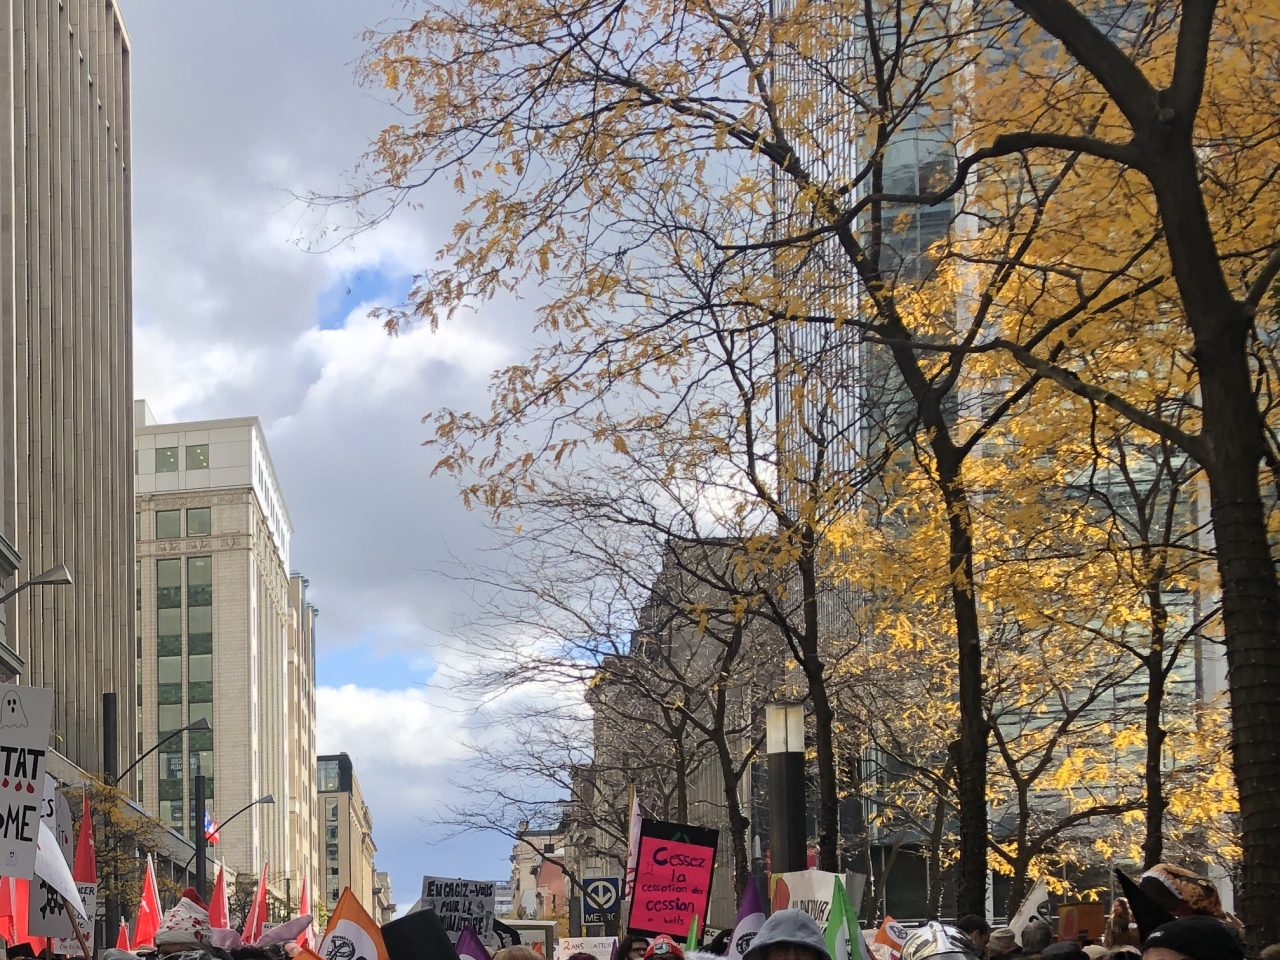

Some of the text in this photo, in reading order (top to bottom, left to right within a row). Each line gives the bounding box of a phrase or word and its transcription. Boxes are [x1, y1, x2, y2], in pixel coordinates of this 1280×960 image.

[653, 847, 706, 868] Cessez
[672, 869, 686, 883] la
[563, 940, 571, 951] 2
